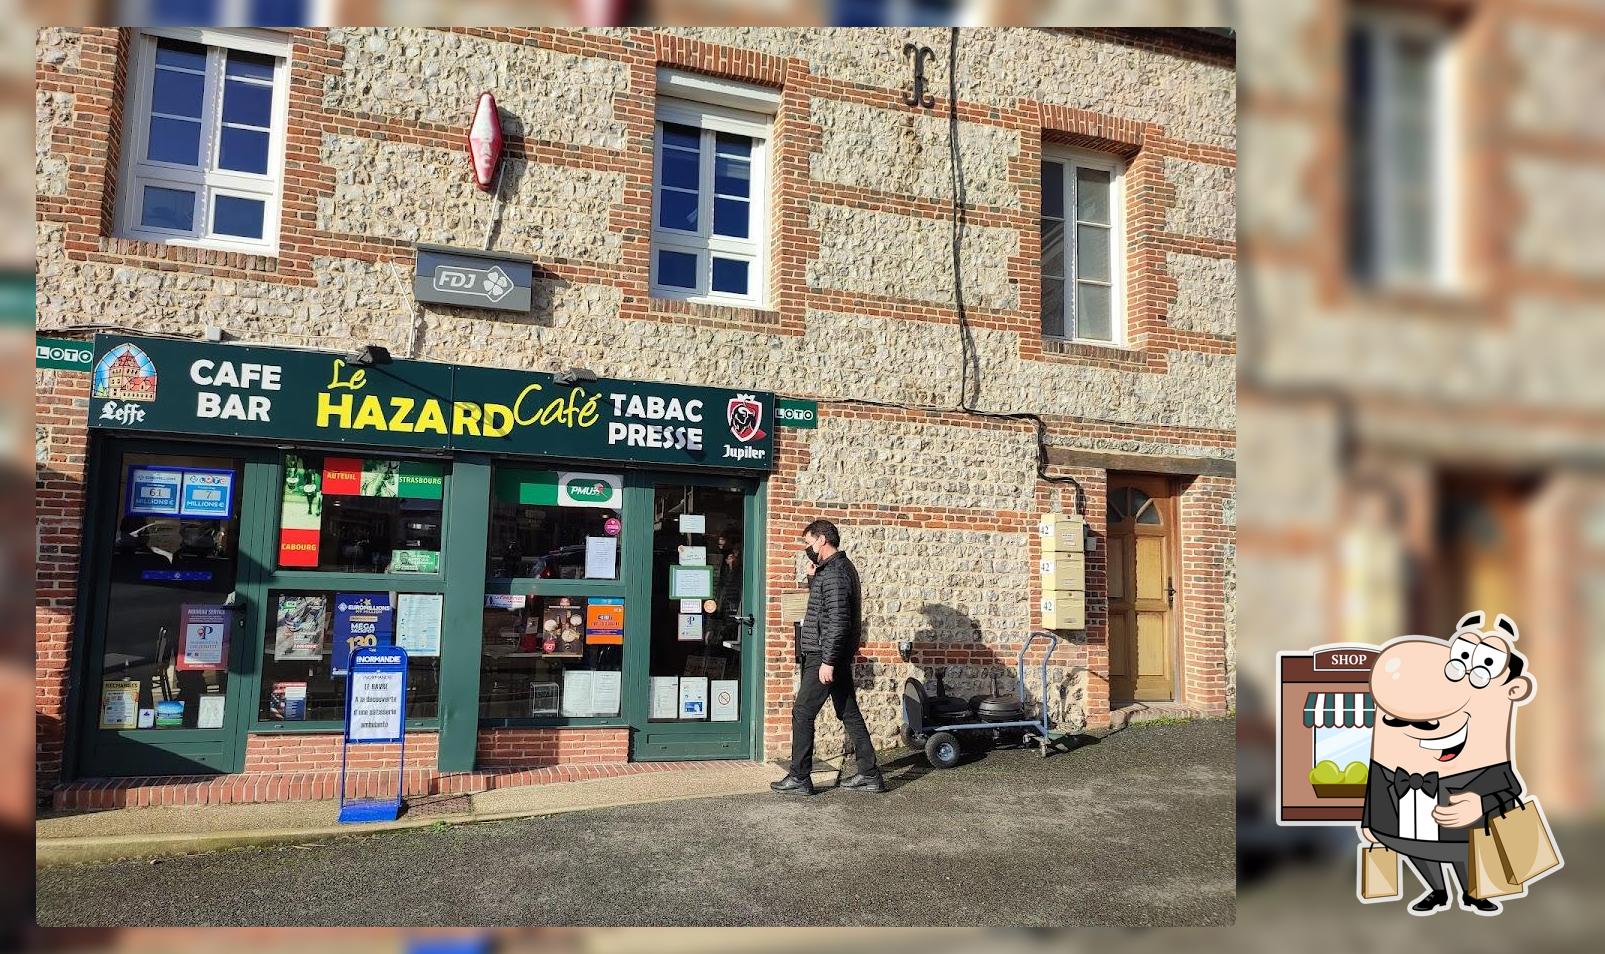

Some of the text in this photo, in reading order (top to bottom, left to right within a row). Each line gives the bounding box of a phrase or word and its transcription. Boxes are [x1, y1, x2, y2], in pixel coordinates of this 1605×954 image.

[439, 271, 477, 288] FDJ
[36, 346, 93, 363] LOTO
[190, 359, 282, 391] CAFE
[327, 358, 367, 390] Le
[99, 400, 146, 425] Leffe
[197, 391, 272, 422] BAR
[316, 383, 602, 437] HAZARD Café
[610, 393, 704, 422] TABAC
[775, 408, 814, 420] LOTO
[608, 422, 703, 450] PRESSE
[722, 444, 766, 461] Jupiler
[327, 472, 356, 481] AUTEUIL
[399, 477, 442, 485] STRASBOURG
[571, 486, 596, 496] PMU
[1041, 525, 1049, 534] 42
[281, 543, 317, 552] CABOURG
[1042, 562, 1050, 572] 42
[1044, 601, 1052, 611] 42
